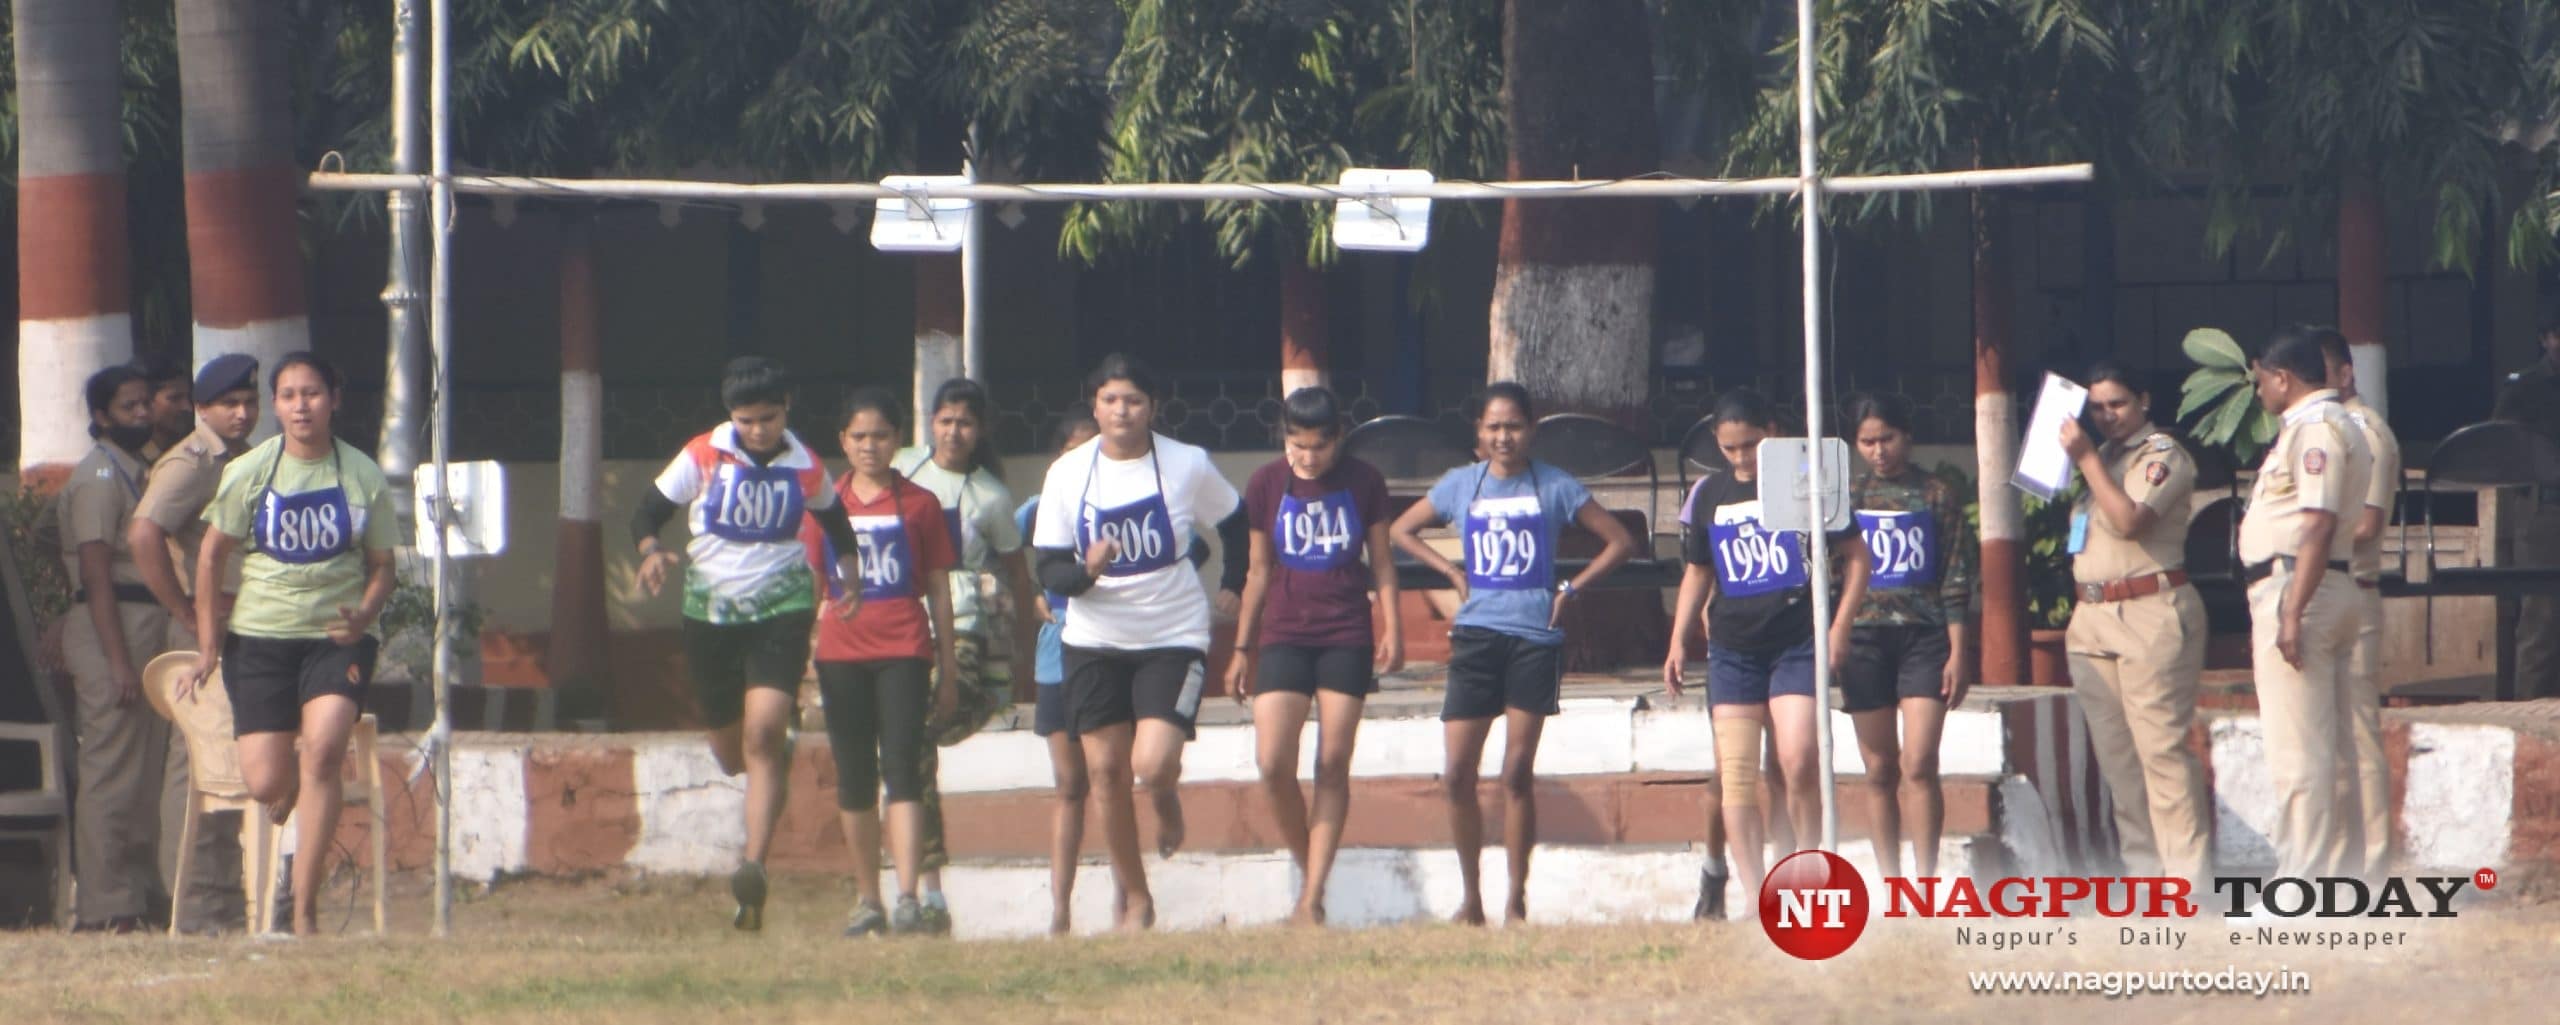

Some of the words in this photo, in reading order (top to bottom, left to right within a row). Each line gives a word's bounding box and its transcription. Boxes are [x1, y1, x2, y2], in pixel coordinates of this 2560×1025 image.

[265, 502, 340, 552] 1808
[716, 479, 790, 529] 1807
[1282, 505, 1351, 556] 1944
[1471, 529, 1536, 576] 1929
[1719, 531, 1789, 582] 1996
